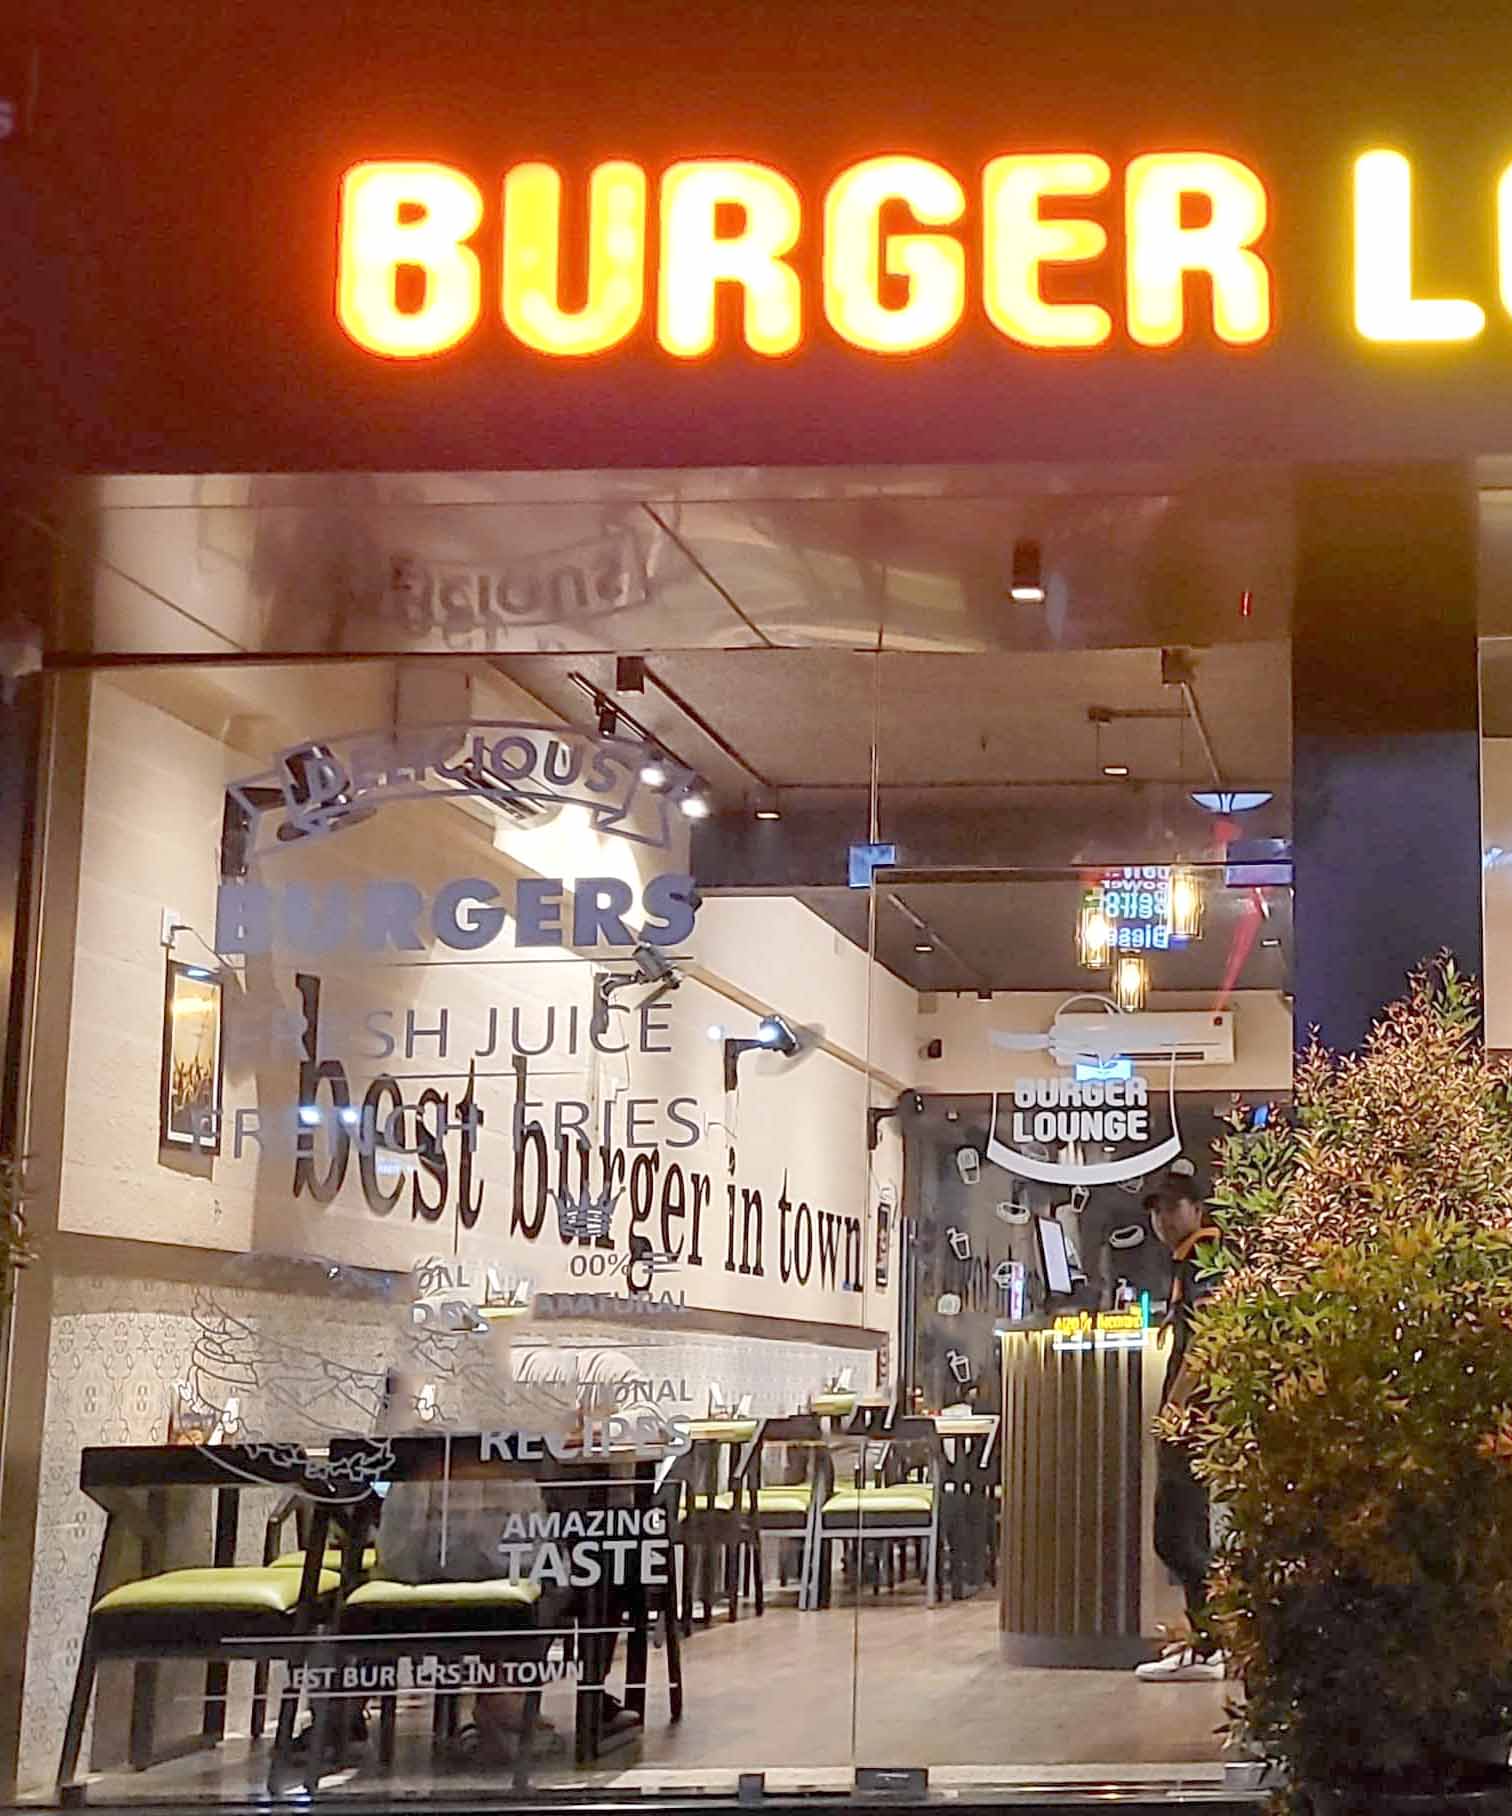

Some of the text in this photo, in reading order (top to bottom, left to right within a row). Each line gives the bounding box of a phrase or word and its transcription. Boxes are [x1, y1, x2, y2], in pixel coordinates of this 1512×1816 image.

[338, 151, 1270, 358] BURGER
[215, 873, 696, 955] BURGERS
[475, 1003, 672, 1058] JUICE
[1013, 1077, 1148, 1108] BURGER
[293, 973, 485, 1229] best
[724, 1145, 765, 1277] in
[778, 1167, 864, 1293] town
[513, 1097, 700, 1151] FRIES
[1013, 1110, 1148, 1143] LOUNGE
[503, 1507, 667, 1539] AMAZING
[498, 1539, 670, 1587] TASTE
[502, 1660, 584, 1682] TOWN
